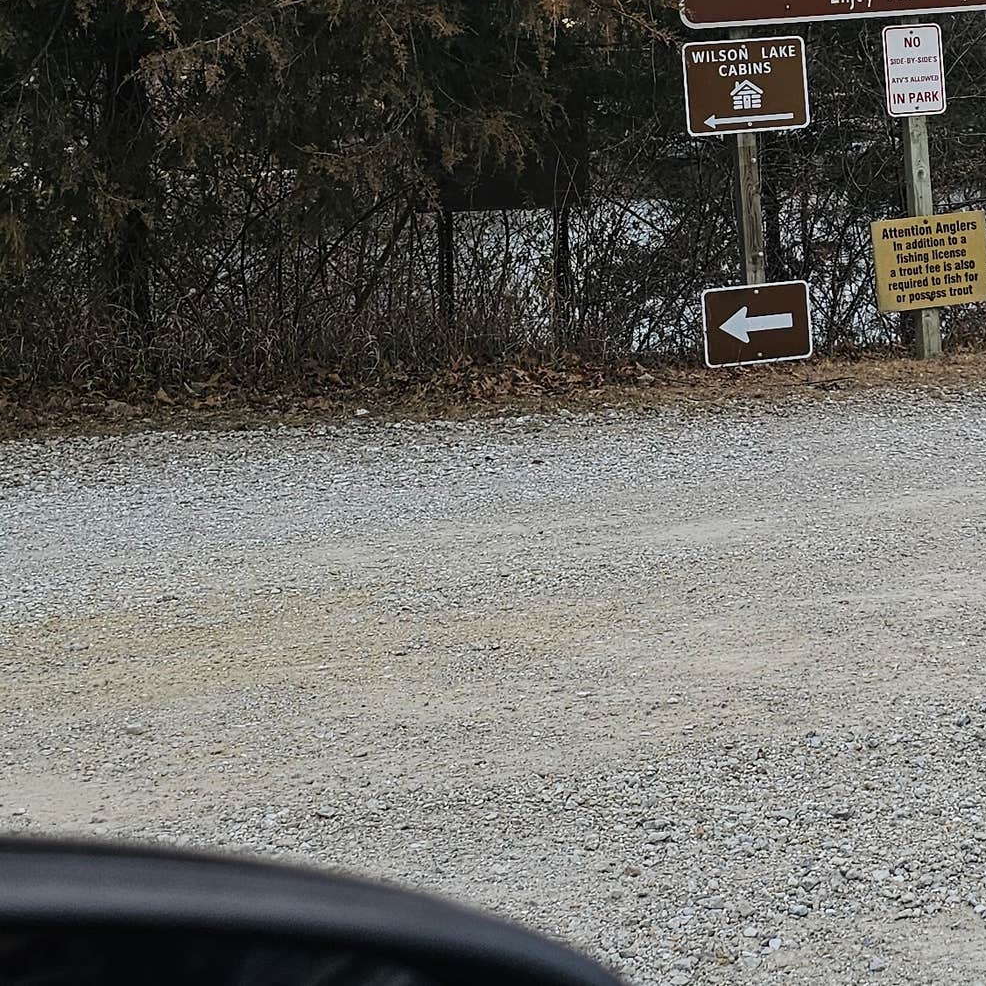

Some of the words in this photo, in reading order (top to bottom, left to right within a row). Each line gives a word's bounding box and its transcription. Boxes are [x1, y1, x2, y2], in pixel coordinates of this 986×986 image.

[904, 36, 920, 48] NO
[692, 48, 748, 64] WILSON
[761, 45, 796, 59] LAKE
[719, 61, 772, 77] CABINS
[910, 74, 939, 83] ALLOWED
[893, 93, 905, 105] IN
[908, 90, 939, 104] PARK
[882, 224, 932, 240] Attention
[936, 220, 977, 235] Anglers
[893, 241, 903, 251] In
[905, 237, 945, 250] addition
[948, 236, 958, 246] to
[960, 236, 967, 244] a
[896, 251, 929, 264] fishing
[932, 248, 967, 260] license
[890, 269, 896, 278] a
[899, 265, 923, 277] trout
[925, 263, 940, 274] fee
[943, 261, 952, 272] is
[955, 259, 975, 271] also
[888, 276, 929, 292] required
[931, 275, 941, 286] to
[944, 273, 962, 285] fish
[964, 272, 979, 282] for
[896, 294, 906, 303] or
[909, 289, 947, 303] possess
[949, 284, 973, 296] trout
